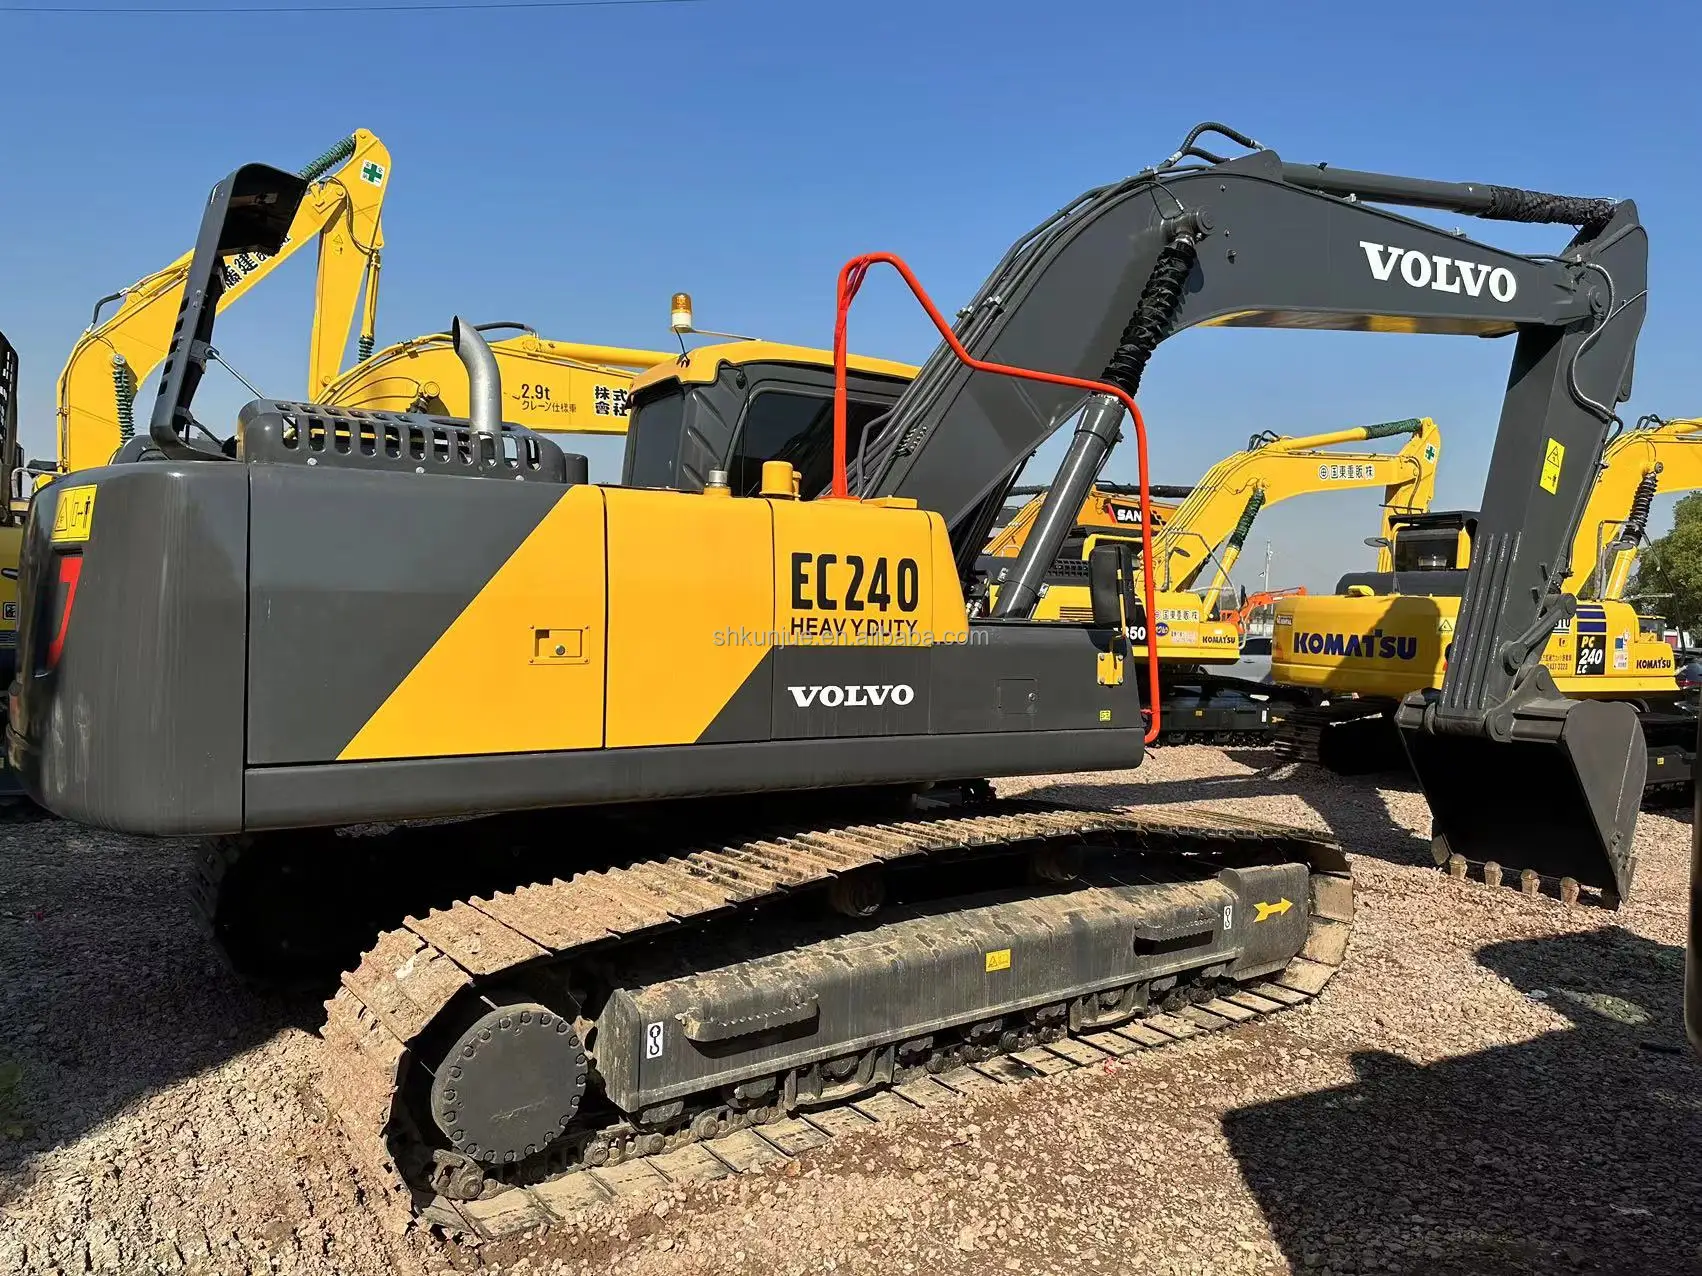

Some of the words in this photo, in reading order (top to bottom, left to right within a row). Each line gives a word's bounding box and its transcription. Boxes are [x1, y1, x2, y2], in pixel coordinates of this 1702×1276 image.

[1359, 240, 1517, 303] VOLVO
[521, 384, 551, 401] 2.9t
[595, 386, 628, 402] 株式
[1117, 509, 1143, 522] SAN
[791, 552, 919, 613] EC240
[1202, 634, 1236, 644] KOMATSU
[1293, 629, 1417, 660] KOMATSU
[1581, 636, 1595, 648] PC
[1579, 648, 1603, 665] 240
[1636, 657, 1672, 669] KOMATSU
[1576, 664, 1588, 674] LC
[787, 684, 915, 708] VOLVO
